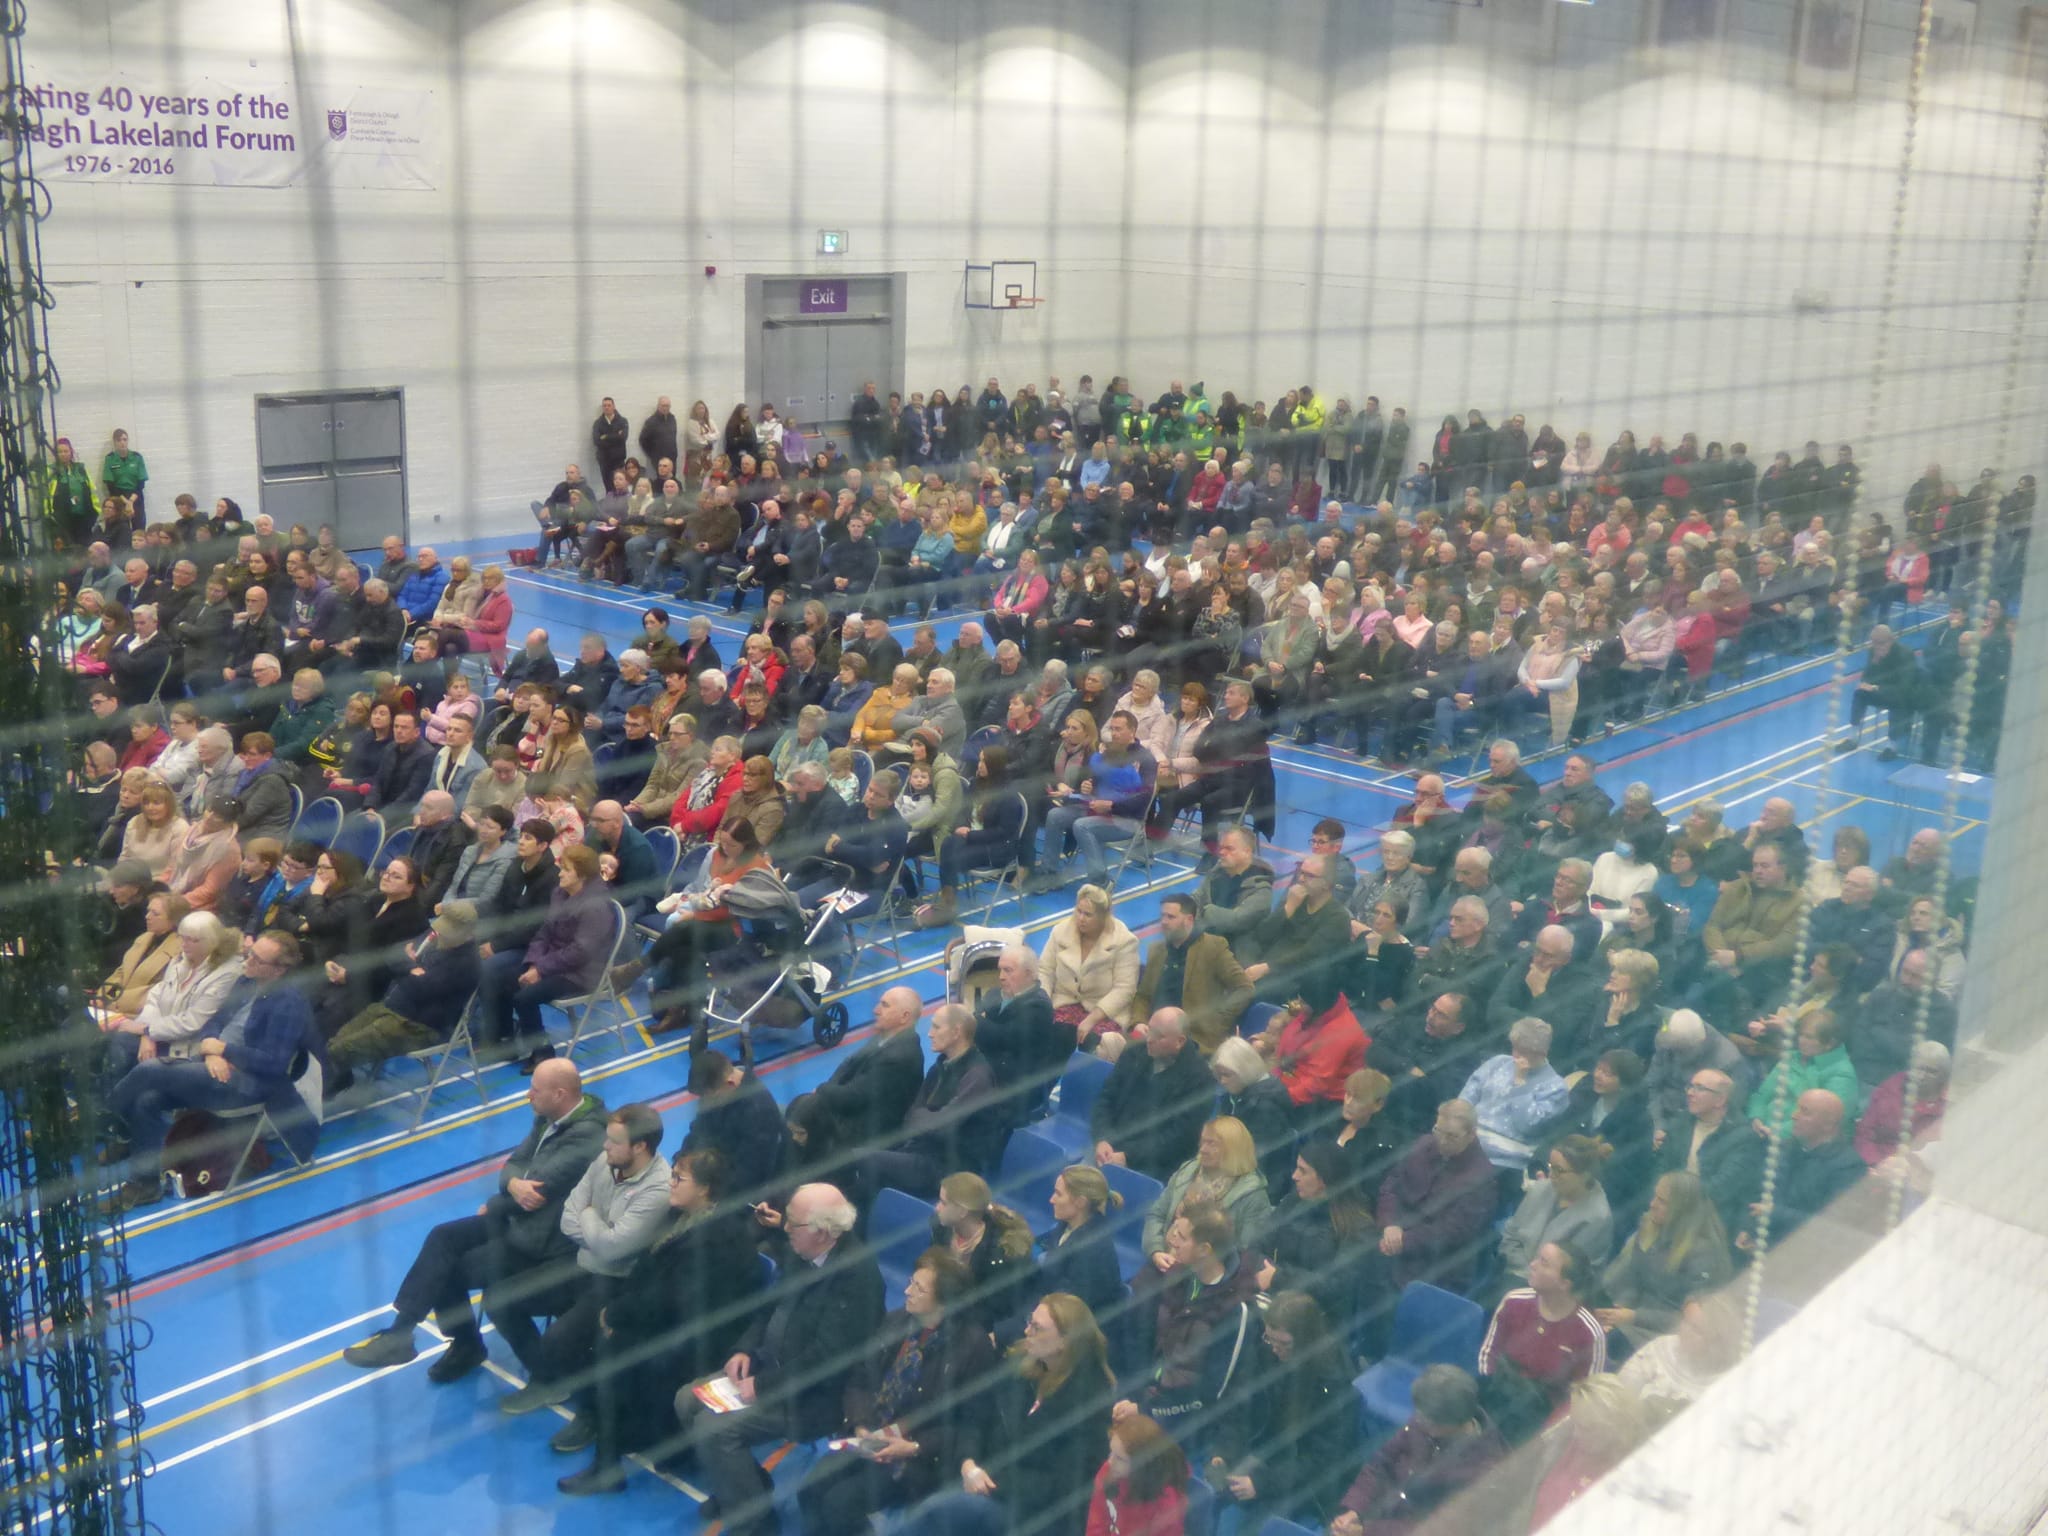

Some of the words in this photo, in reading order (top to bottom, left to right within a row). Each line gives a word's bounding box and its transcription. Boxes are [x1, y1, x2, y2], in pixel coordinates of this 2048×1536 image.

[97, 86, 133, 112] 40
[139, 95, 209, 119] years
[216, 93, 243, 118] of
[248, 94, 290, 120] the
[89, 119, 208, 149] Lakeland
[215, 124, 296, 152] Forum
[65, 155, 112, 173] 1976
[129, 157, 175, 175] 2016
[811, 287, 836, 305] Exit
